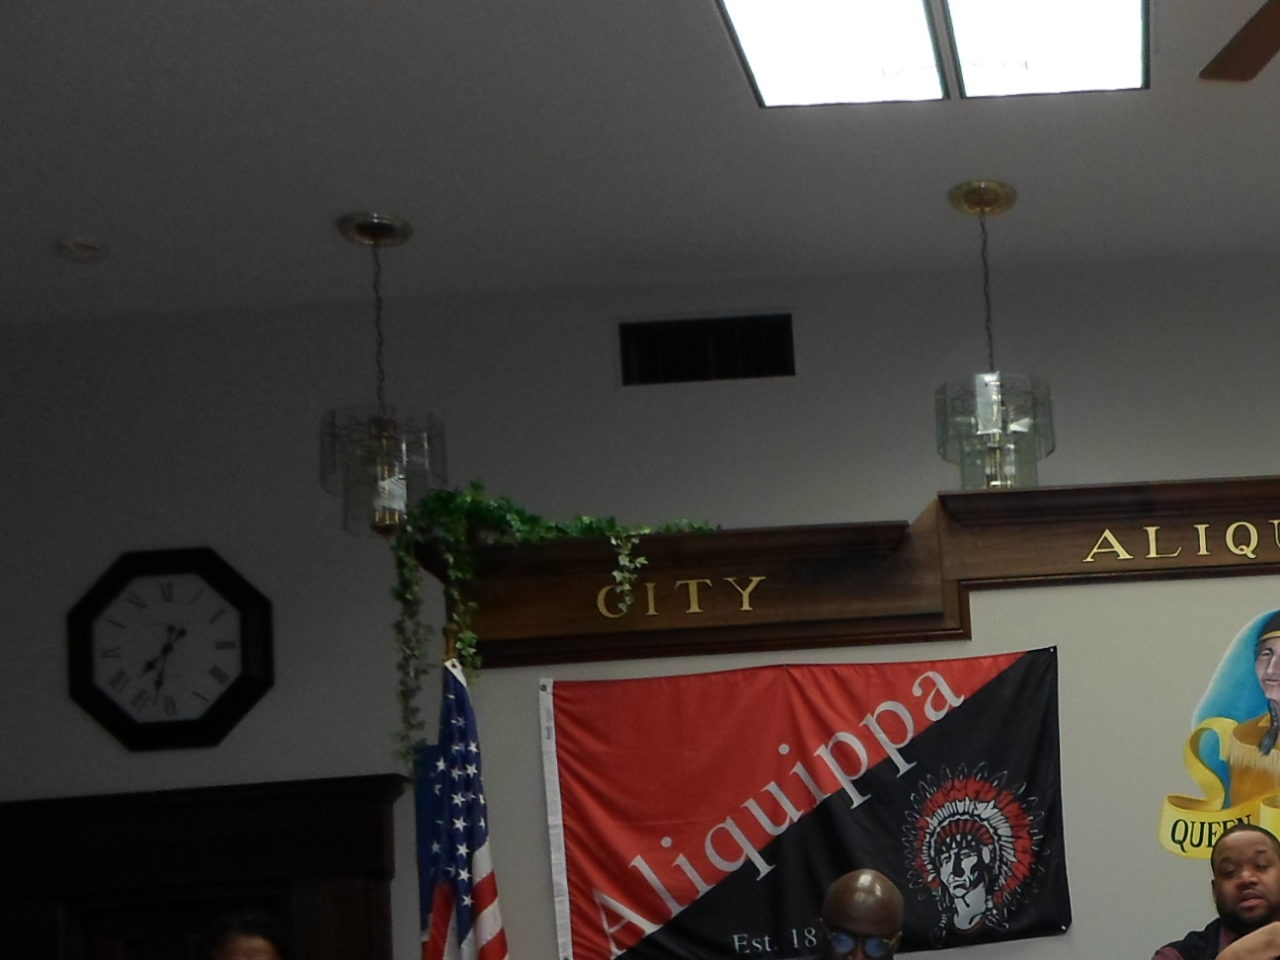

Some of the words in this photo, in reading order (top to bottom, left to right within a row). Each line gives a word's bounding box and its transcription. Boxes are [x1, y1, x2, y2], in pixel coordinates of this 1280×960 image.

[596, 576, 767, 619] CITY
[732, 933, 778, 953] Est.
[792, 927, 817, 949] 18
